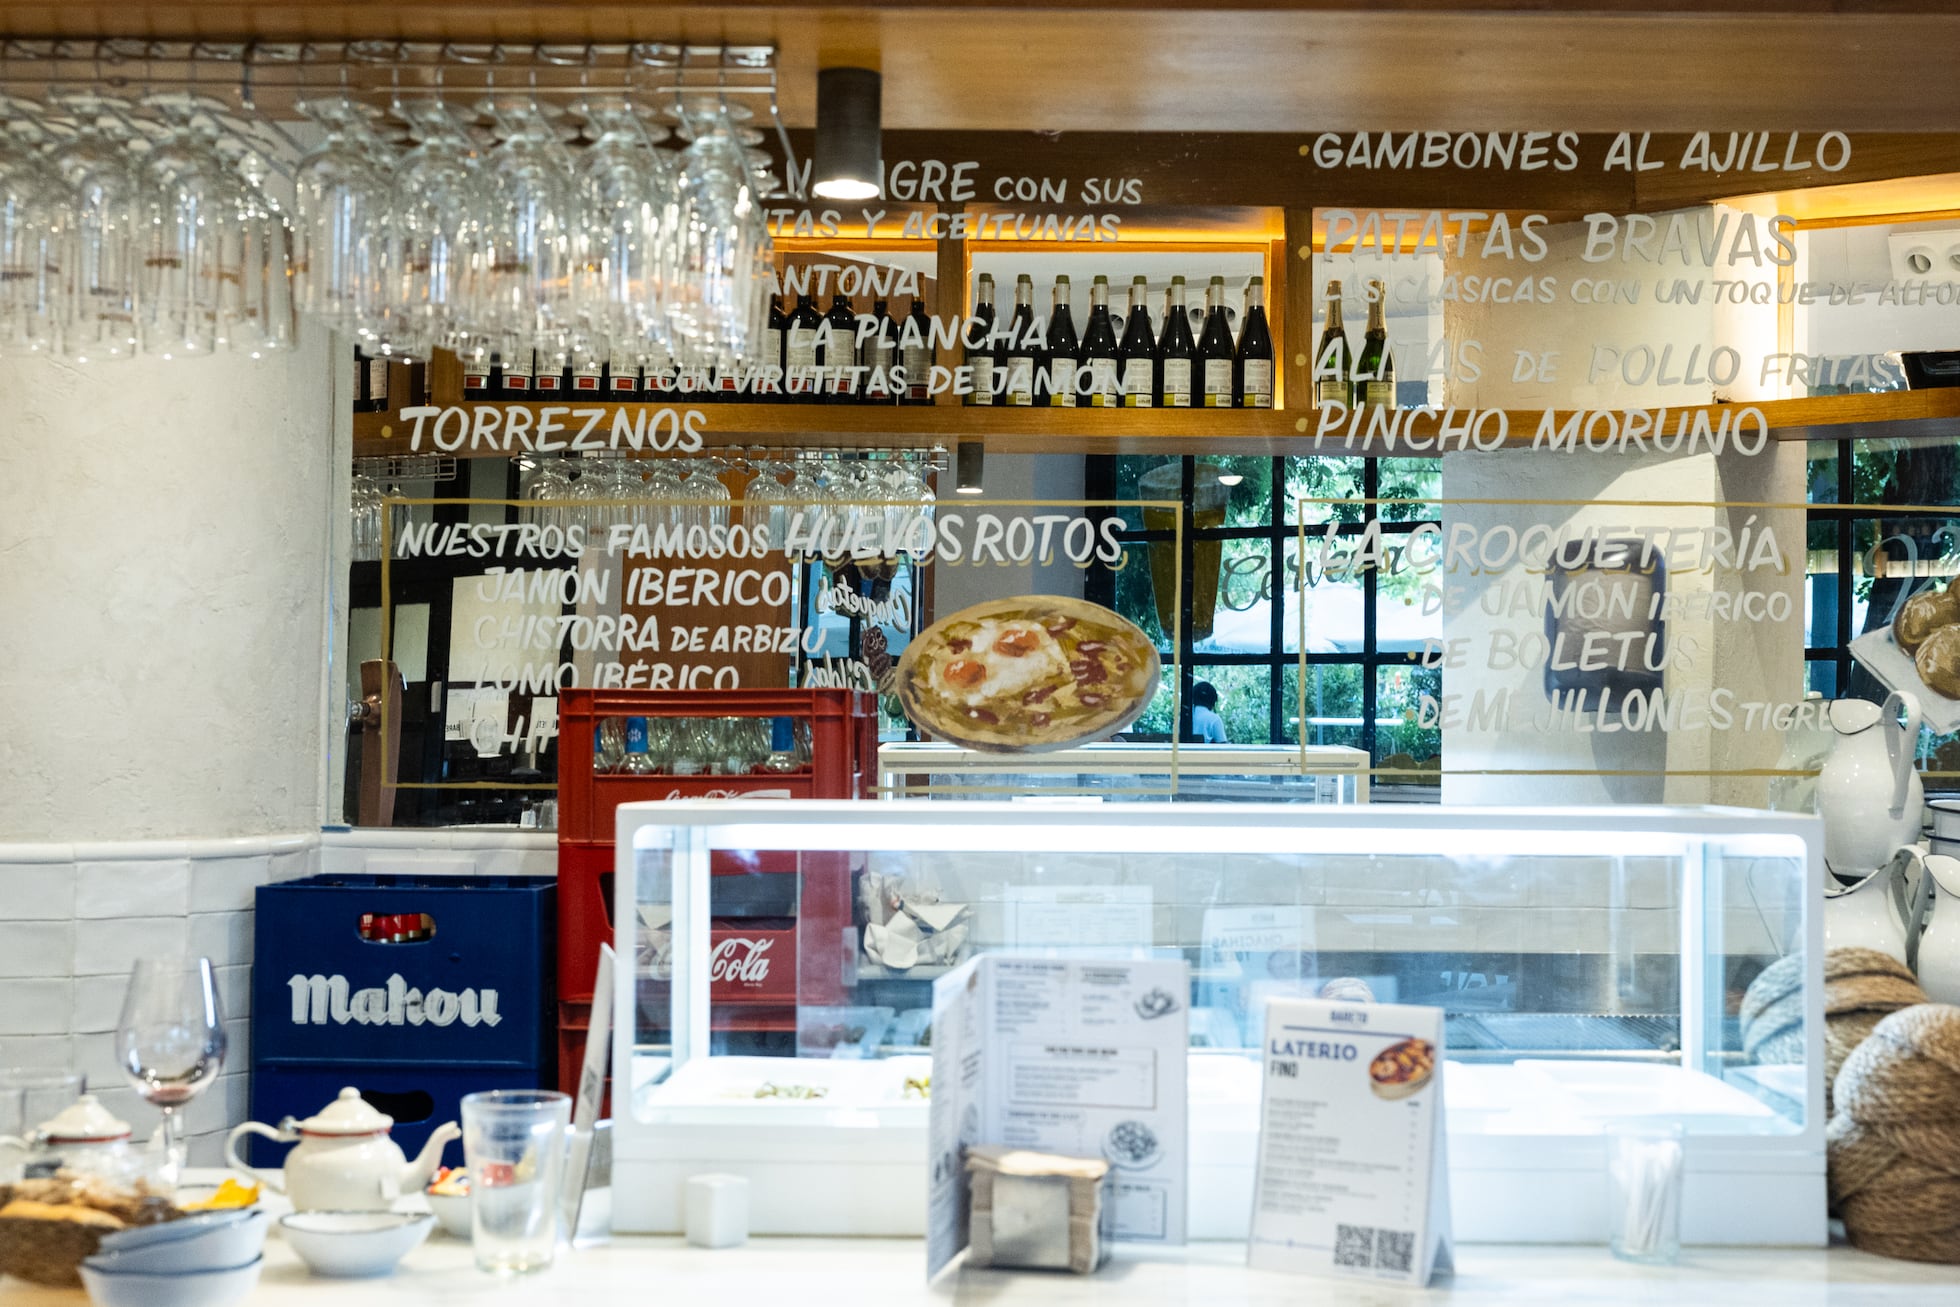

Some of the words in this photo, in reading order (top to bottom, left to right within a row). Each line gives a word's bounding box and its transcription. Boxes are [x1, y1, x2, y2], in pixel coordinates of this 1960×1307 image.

[1313, 130, 1579, 170] GAMBONES
[1604, 131, 1664, 171] AL
[1680, 130, 1852, 172] AJILLO
[994, 176, 1067, 204] CON
[1081, 177, 1143, 205] SUS
[862, 208, 886, 237] Y
[902, 210, 1121, 243] ACEITUNAS
[1320, 208, 1549, 263] PATATAS
[1581, 212, 1799, 267] BRAVAS
[1394, 271, 1557, 304] CLÁSICAS
[1570, 278, 1641, 304] CON
[1655, 279, 1706, 305] UN
[1711, 280, 1815, 306] TOQUE
[1829, 280, 1867, 306] DE
[789, 317, 835, 350] LA
[854, 314, 1049, 352] PLANCHA
[656, 366, 722, 393] CON
[734, 364, 908, 396] VIRUTITAS
[927, 365, 975, 396] DE
[988, 358, 1131, 396] JAMÓN
[1312, 335, 1484, 384] ALITAS
[1511, 349, 1560, 384] DE
[1588, 343, 1742, 388] POLLO
[1759, 352, 1895, 388] FRITAS
[400, 406, 707, 452] TORREZNOS
[1313, 400, 1509, 452] PINCHO
[1533, 407, 1768, 457] MORUNO
[397, 521, 585, 560] NUESTROS
[607, 522, 770, 560] FAMOSOS
[784, 512, 965, 566] HUEVOS
[973, 513, 1128, 567] ROTOS
[1319, 518, 1383, 570] LA
[1405, 515, 1785, 572] CROQUETERÍA
[477, 565, 610, 606] JAMÓN
[626, 565, 790, 606] IBÉRICO
[1421, 582, 1455, 618] DE
[1482, 578, 1638, 622] JAMÓN
[473, 614, 660, 653] CHISTORRA
[671, 625, 708, 653] DE
[711, 623, 827, 654] ARBIZU
[1421, 634, 1471, 671] DE
[1486, 629, 1699, 672] BOLETUS
[474, 661, 580, 696] LOMO
[592, 658, 740, 690] IBÉRICO
[1417, 693, 1464, 731] DE
[1466, 686, 1734, 733] MEJILLONES
[286, 972, 502, 1027] Mahou
[1270, 1040, 1358, 1061] LATERIO
